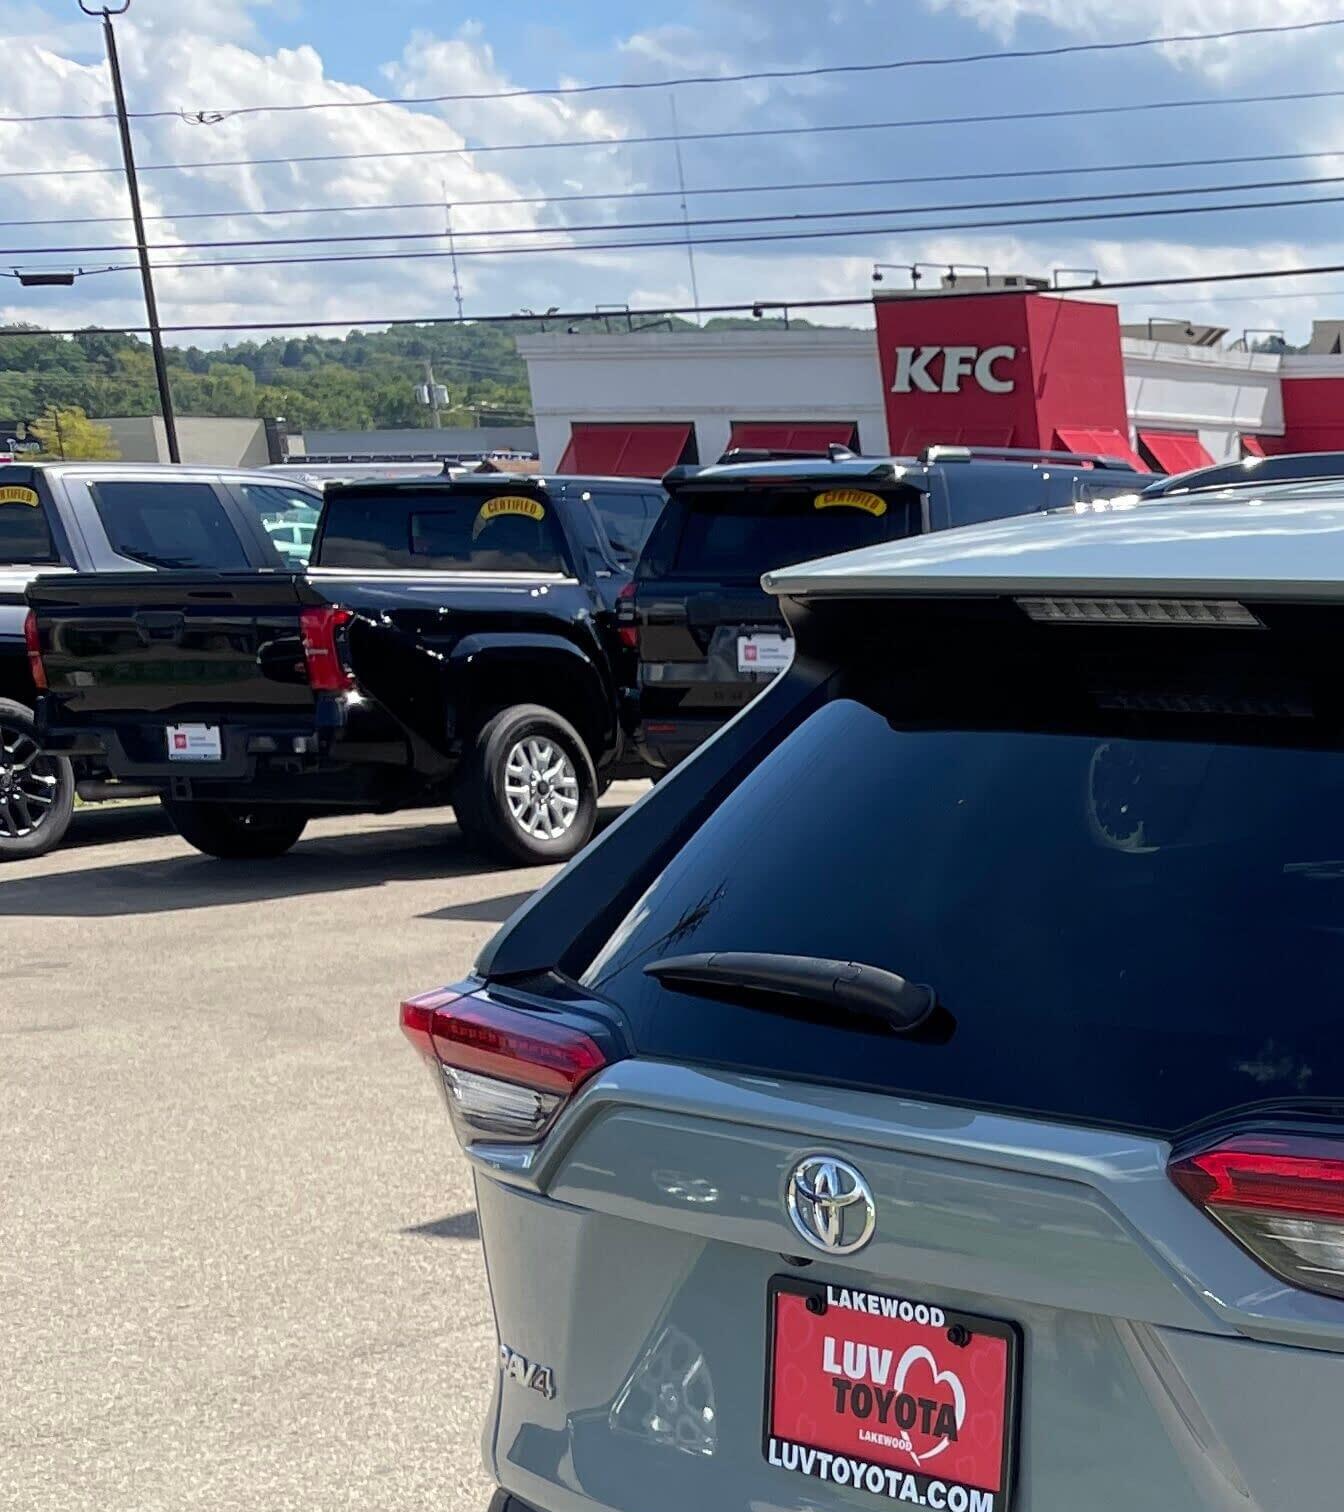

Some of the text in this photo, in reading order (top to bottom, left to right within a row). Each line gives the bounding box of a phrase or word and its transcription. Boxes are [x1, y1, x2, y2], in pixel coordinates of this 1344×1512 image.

[891, 346, 1015, 392] KFC
[487, 499, 537, 514] CERTIFIED
[823, 490, 880, 511] CERTIFIED
[826, 1285, 946, 1328] LAKEWOOD
[822, 1336, 894, 1386] LUV
[832, 1378, 958, 1442] TOYOTA
[858, 1428, 913, 1452] LAKEWOOD
